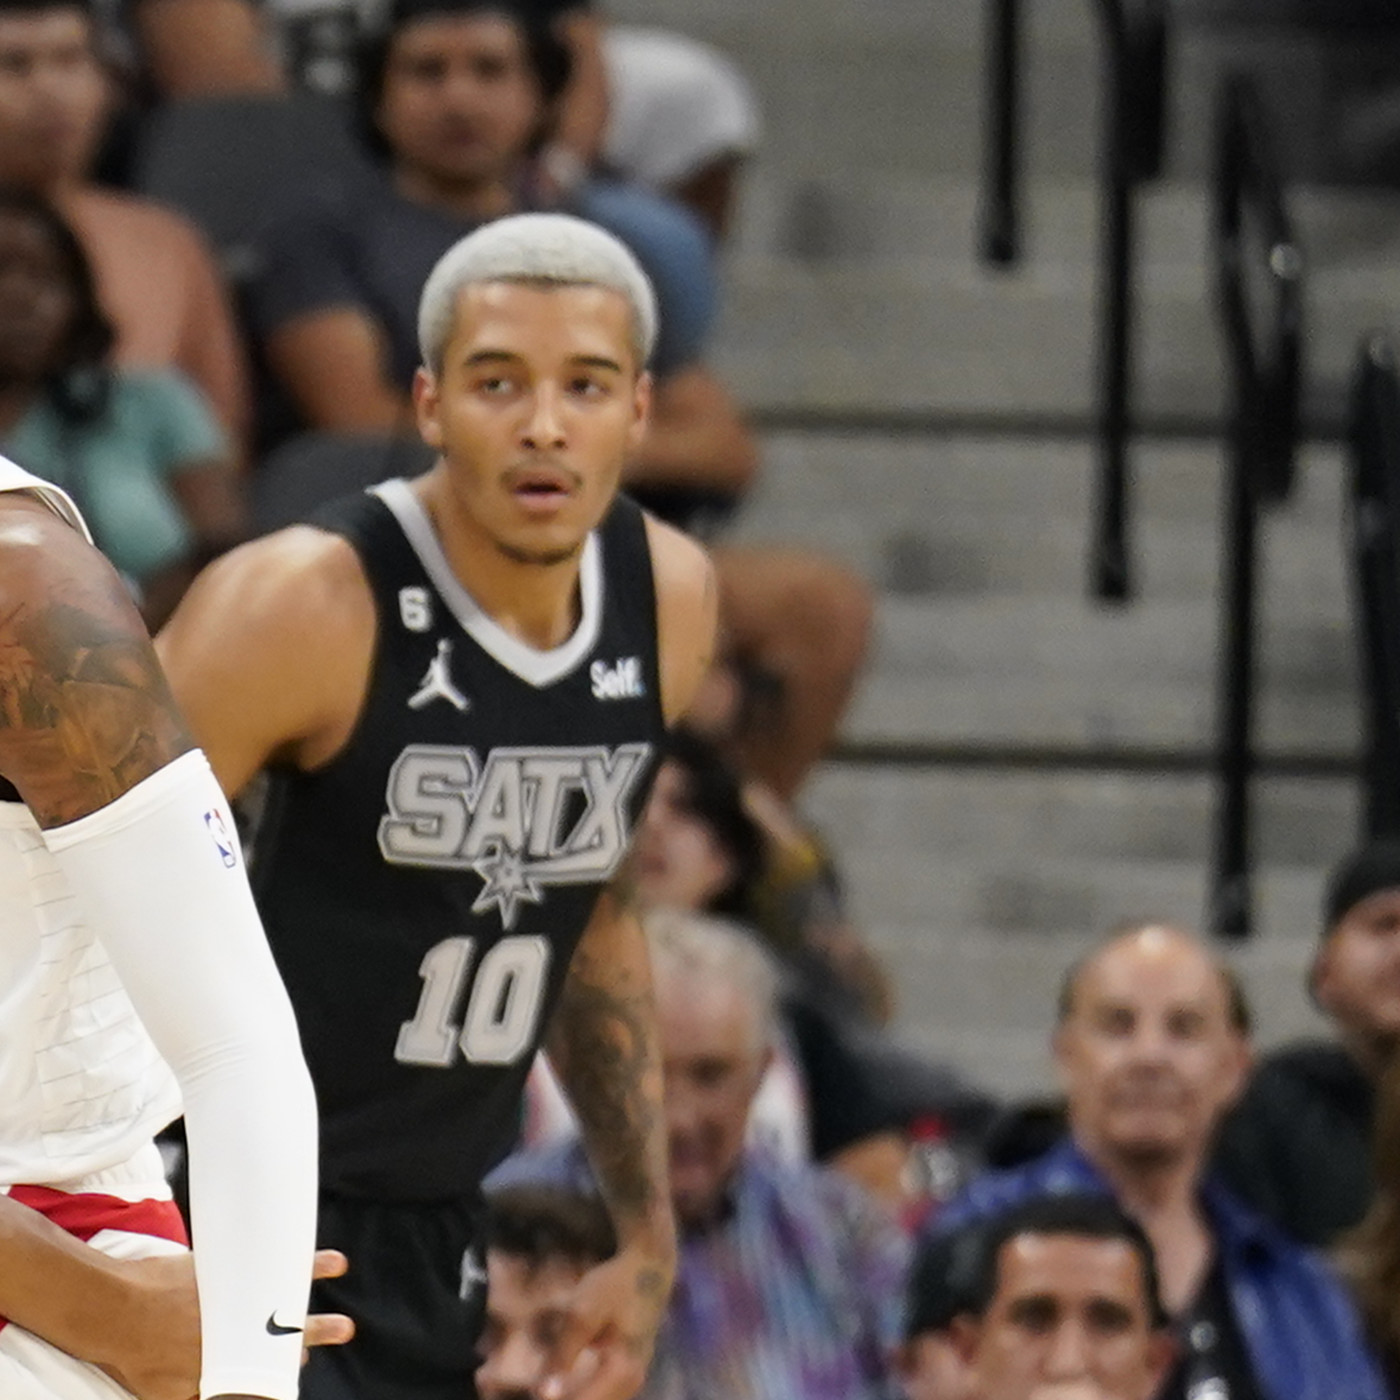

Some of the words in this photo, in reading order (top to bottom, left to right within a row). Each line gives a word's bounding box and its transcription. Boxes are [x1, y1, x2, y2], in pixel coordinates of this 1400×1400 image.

[399, 585, 432, 632] 6
[377, 743, 653, 884] SATX
[394, 934, 550, 1067] 10
